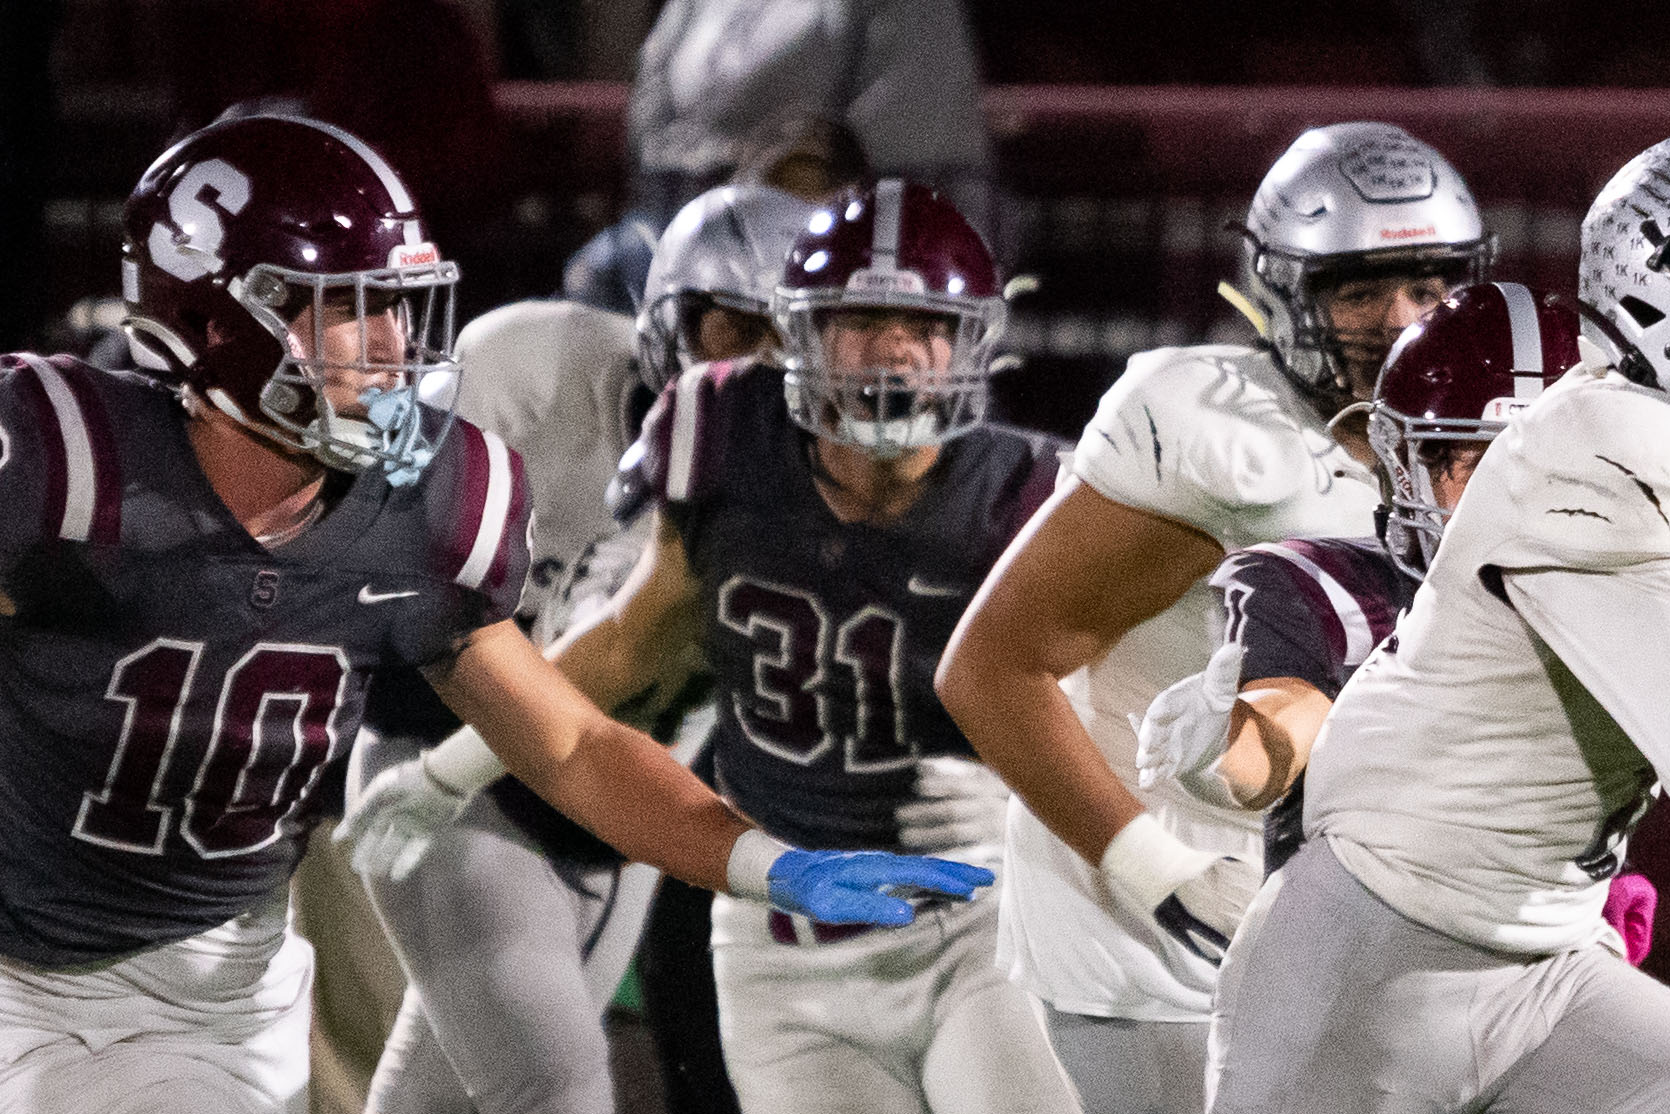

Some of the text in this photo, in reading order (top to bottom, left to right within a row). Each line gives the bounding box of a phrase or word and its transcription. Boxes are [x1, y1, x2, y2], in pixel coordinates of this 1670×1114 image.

[148, 158, 252, 283] S
[70, 637, 352, 860] 10
[718, 575, 919, 773] 31
